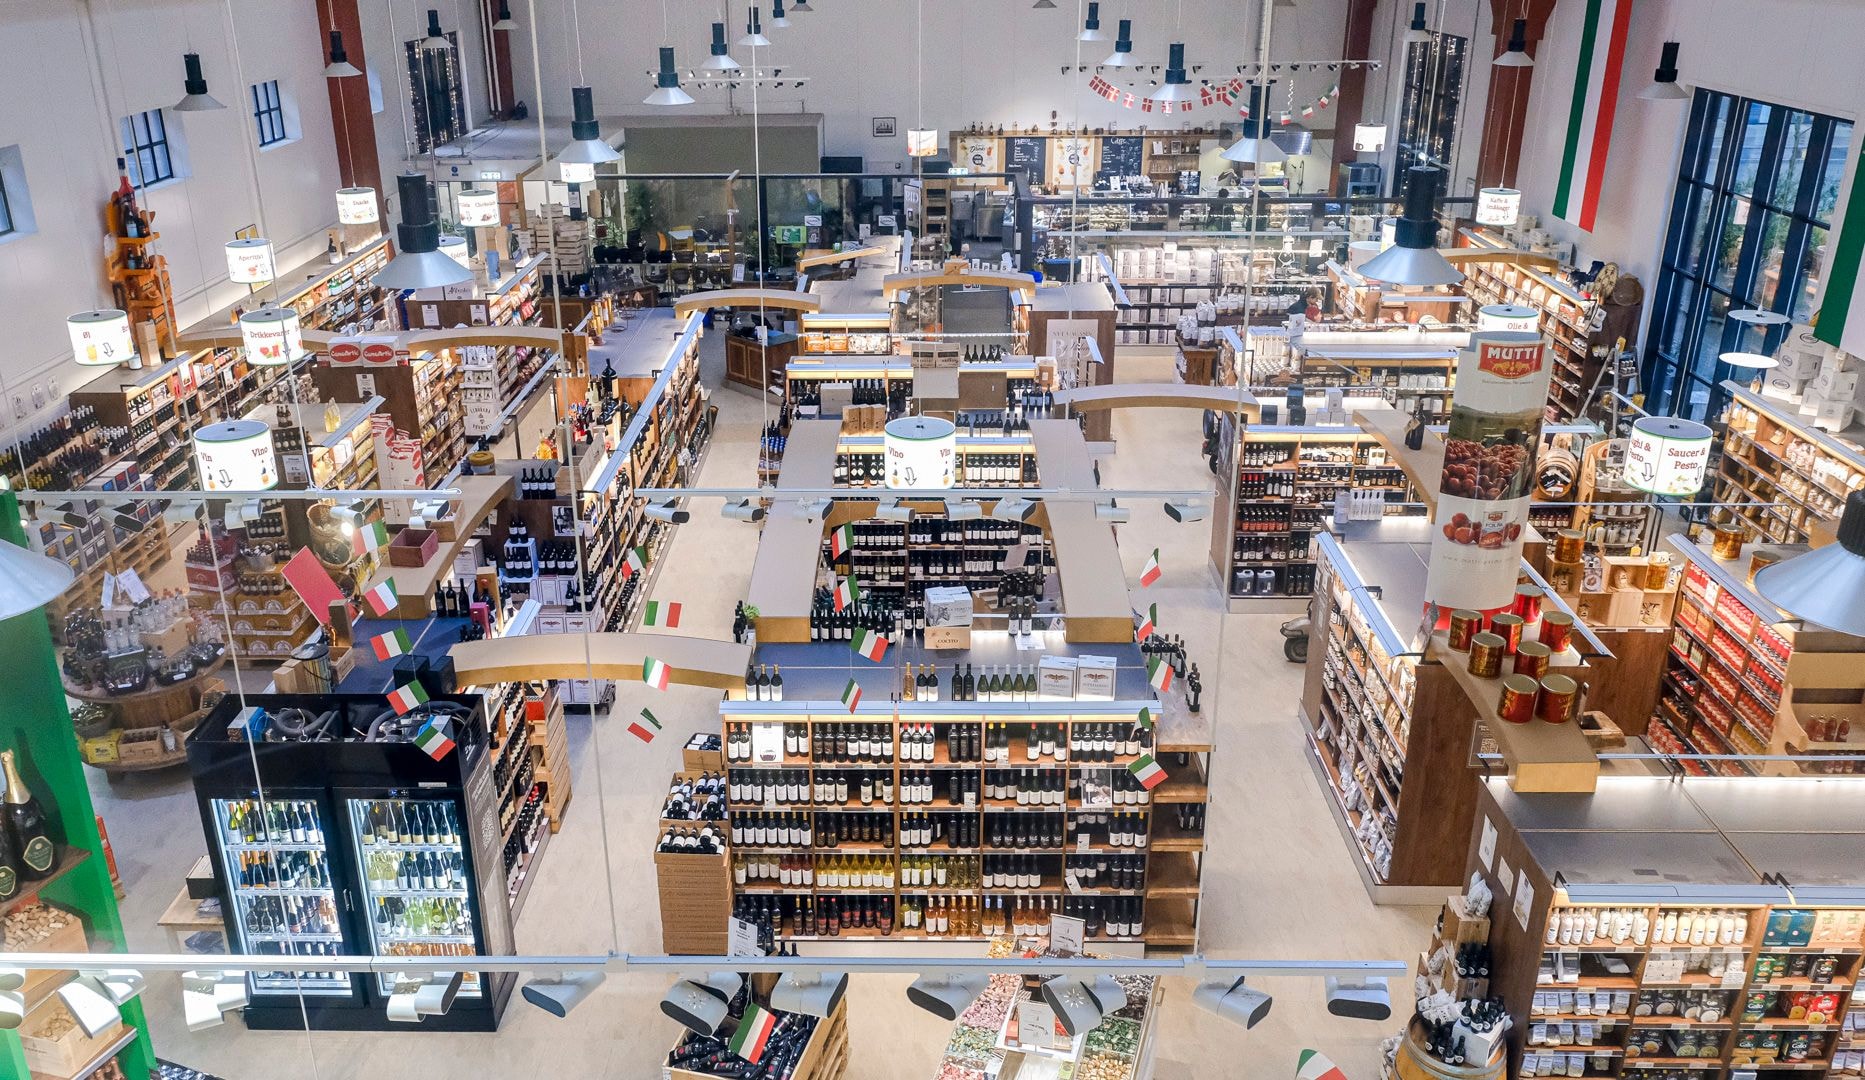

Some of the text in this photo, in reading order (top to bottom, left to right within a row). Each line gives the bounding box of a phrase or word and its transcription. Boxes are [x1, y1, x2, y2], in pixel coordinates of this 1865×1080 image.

[1488, 347, 1538, 360] MUTTI
[201, 452, 213, 462] Vin
[251, 447, 268, 458] Vino
[888, 446, 904, 459] Vino
[1668, 448, 1700, 458] Saucer
[1674, 460, 1698, 470] Pesto
